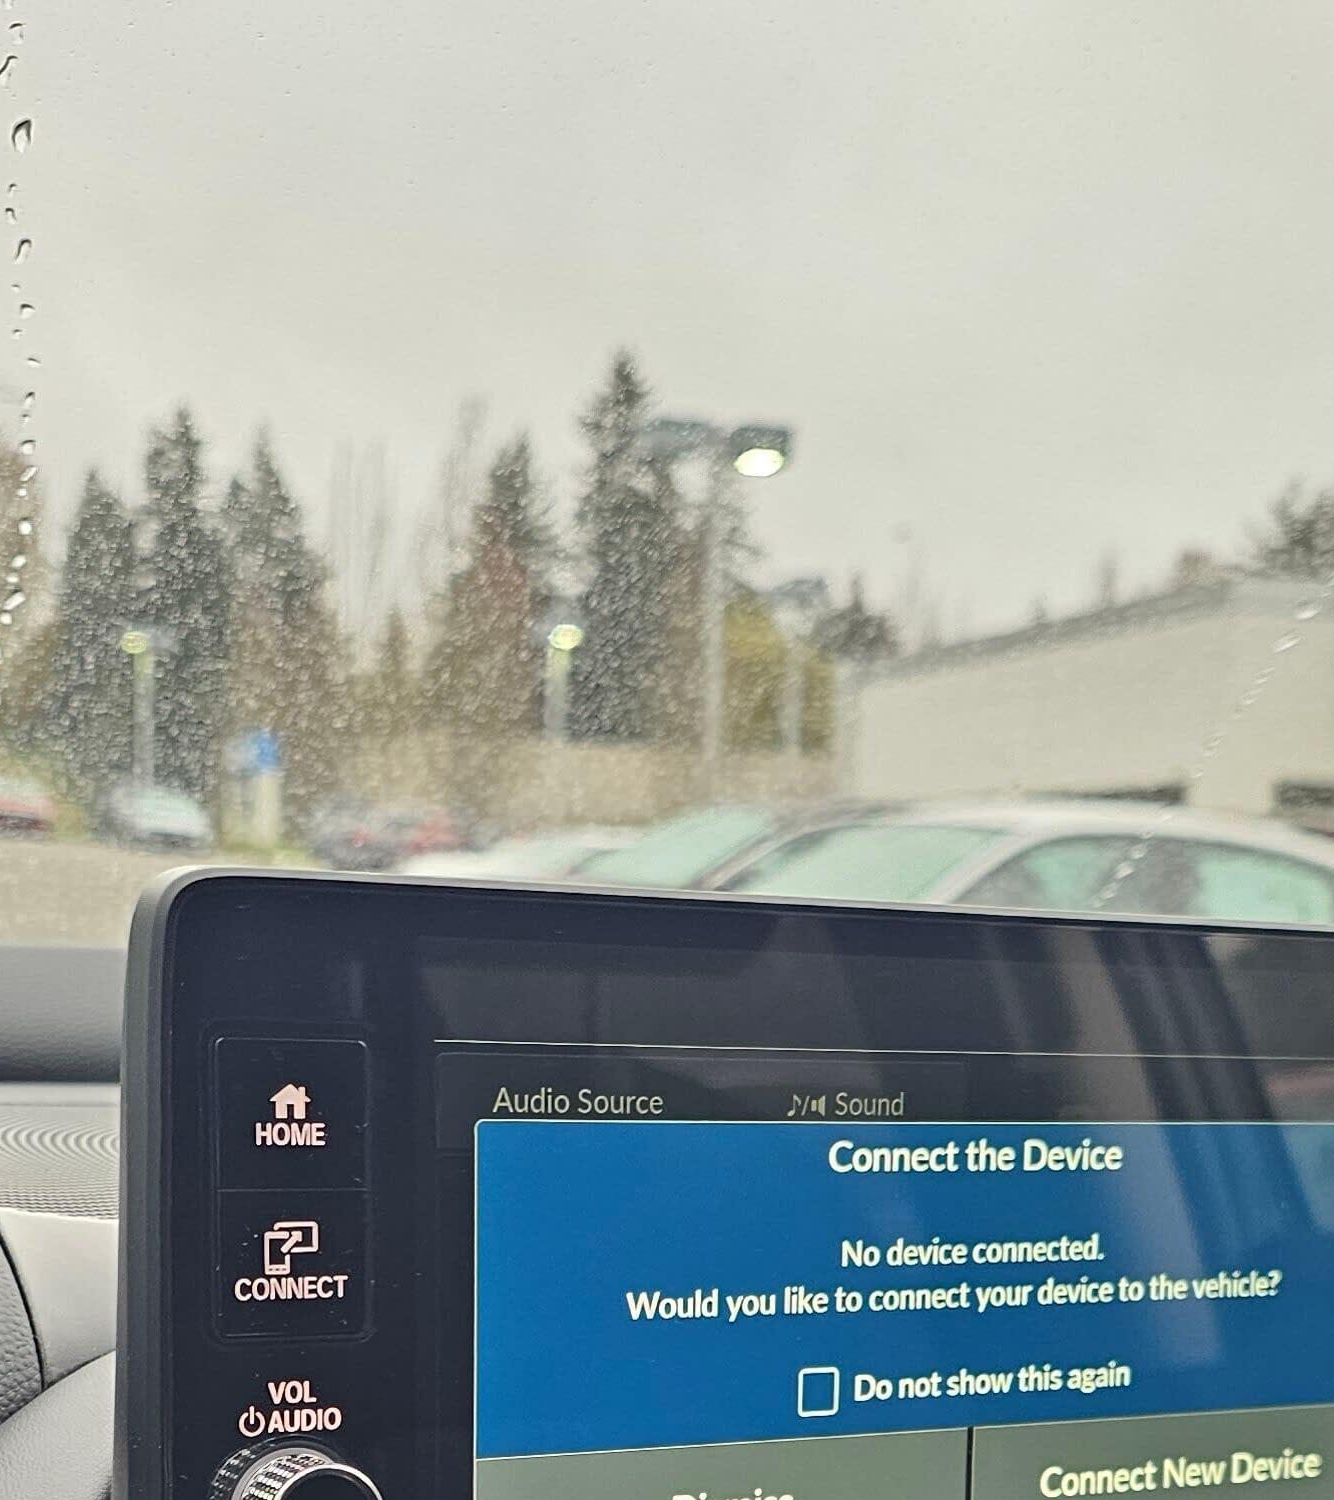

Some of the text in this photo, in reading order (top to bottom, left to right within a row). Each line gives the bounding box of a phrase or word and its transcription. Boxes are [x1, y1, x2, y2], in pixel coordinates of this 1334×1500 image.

[492, 1086, 664, 1115] Audio Source
[834, 1091, 905, 1116] Sound
[255, 1122, 325, 1146] HOME
[828, 1137, 1124, 1173] Connect the Device
[841, 1232, 1106, 1268] No device connected.
[234, 1274, 348, 1300] CONNECT
[627, 1270, 1283, 1323] Would you like to connect your device to the vehicle?
[267, 1380, 317, 1405] VOL
[853, 1359, 1131, 1402] Do not show this again
[268, 1407, 342, 1433] AUDIO
[1039, 1448, 1322, 1498] Connect New Device
